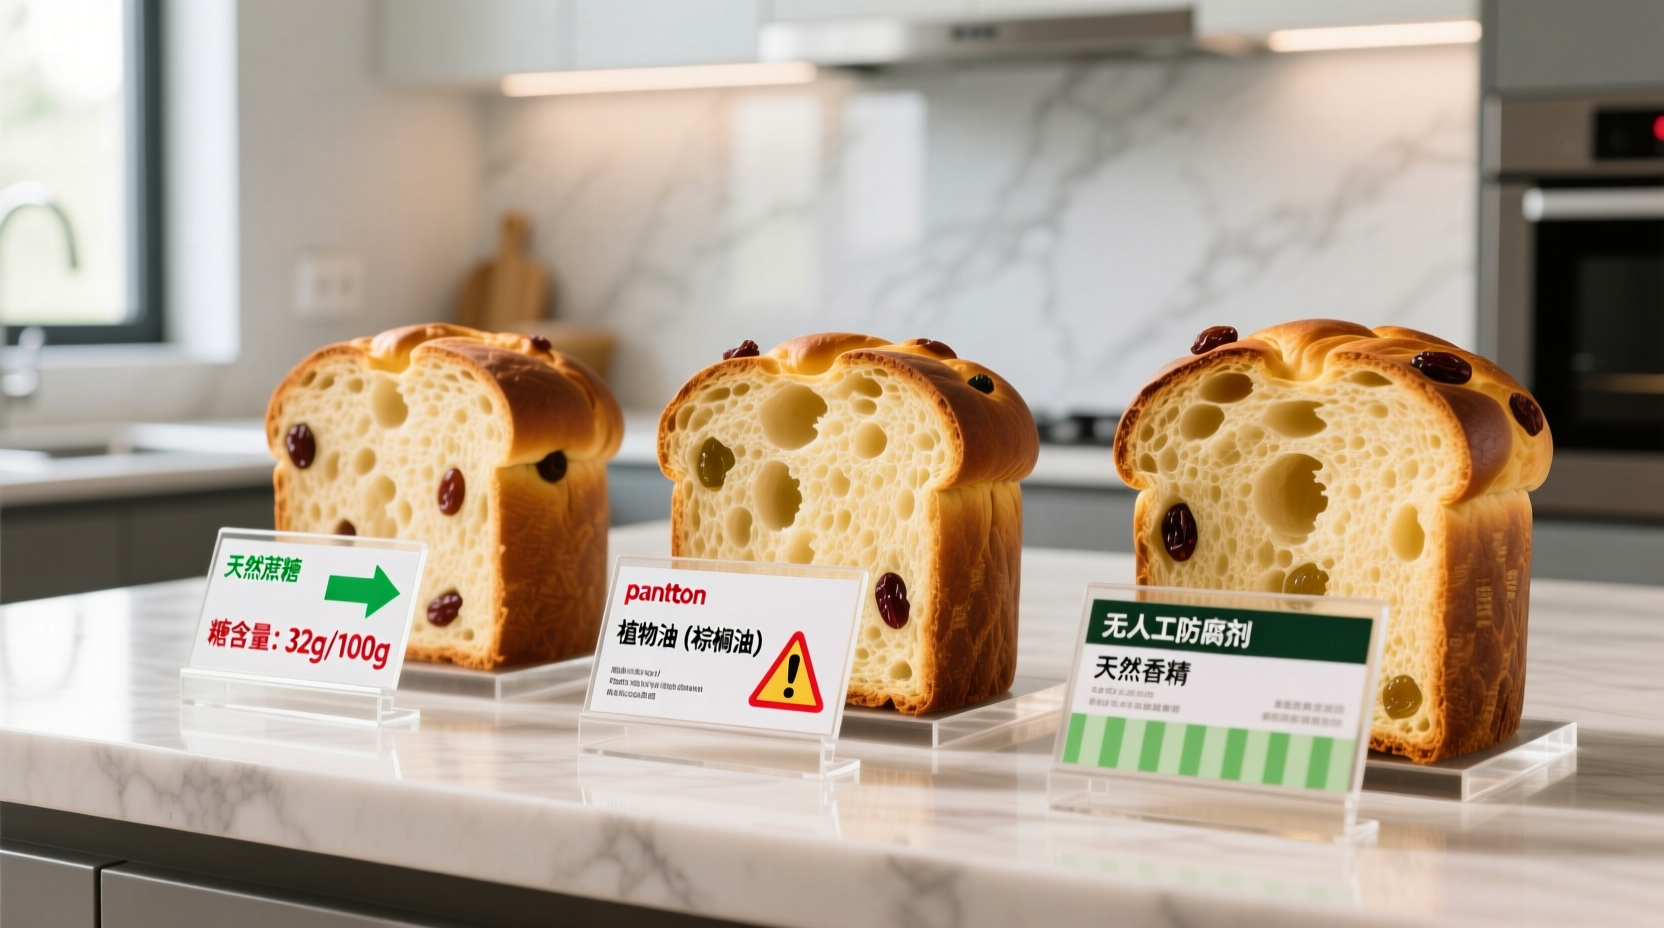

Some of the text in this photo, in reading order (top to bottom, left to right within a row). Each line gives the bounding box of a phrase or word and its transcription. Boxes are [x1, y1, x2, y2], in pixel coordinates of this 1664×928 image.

[224, 554, 302, 582] 天然蔗糖
[624, 583, 707, 605] pantton
[1101, 612, 1253, 649] 无人工防腐剂
[1094, 655, 1192, 687] 天然香精
